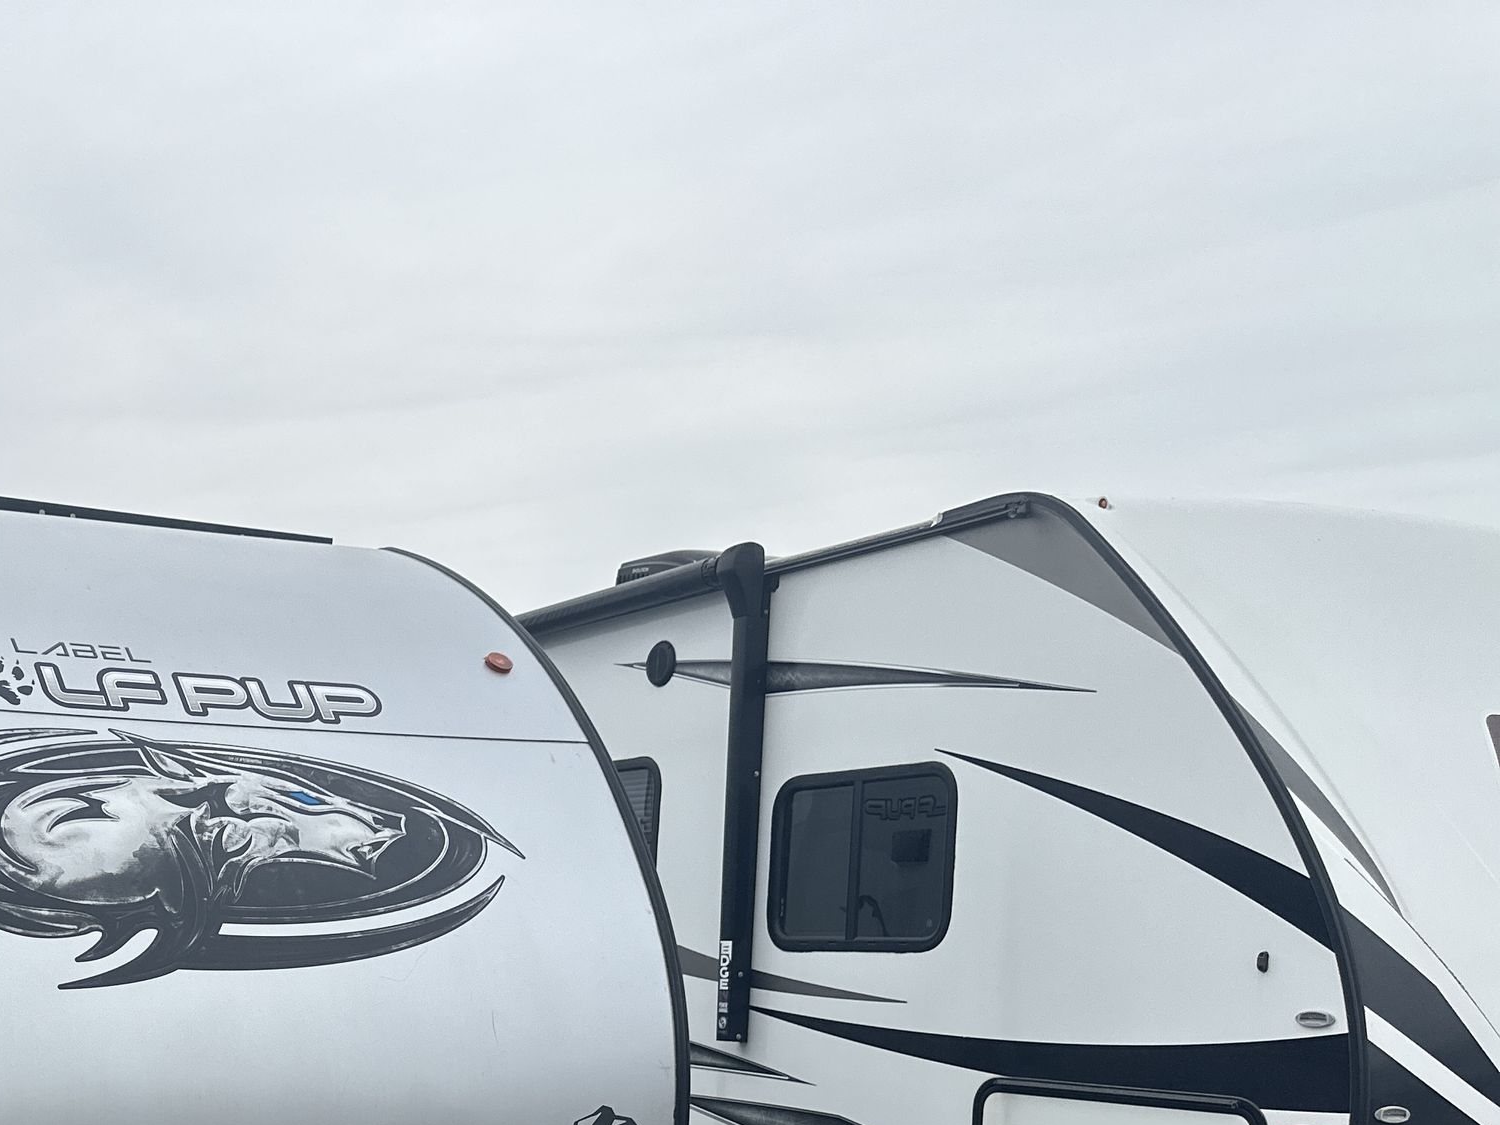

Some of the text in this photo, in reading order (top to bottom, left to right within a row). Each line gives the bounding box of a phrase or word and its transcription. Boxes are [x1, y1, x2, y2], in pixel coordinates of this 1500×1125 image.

[10, 637, 152, 663] LABEL
[171, 672, 382, 724] PUP
[719, 940, 733, 990] EDGE
